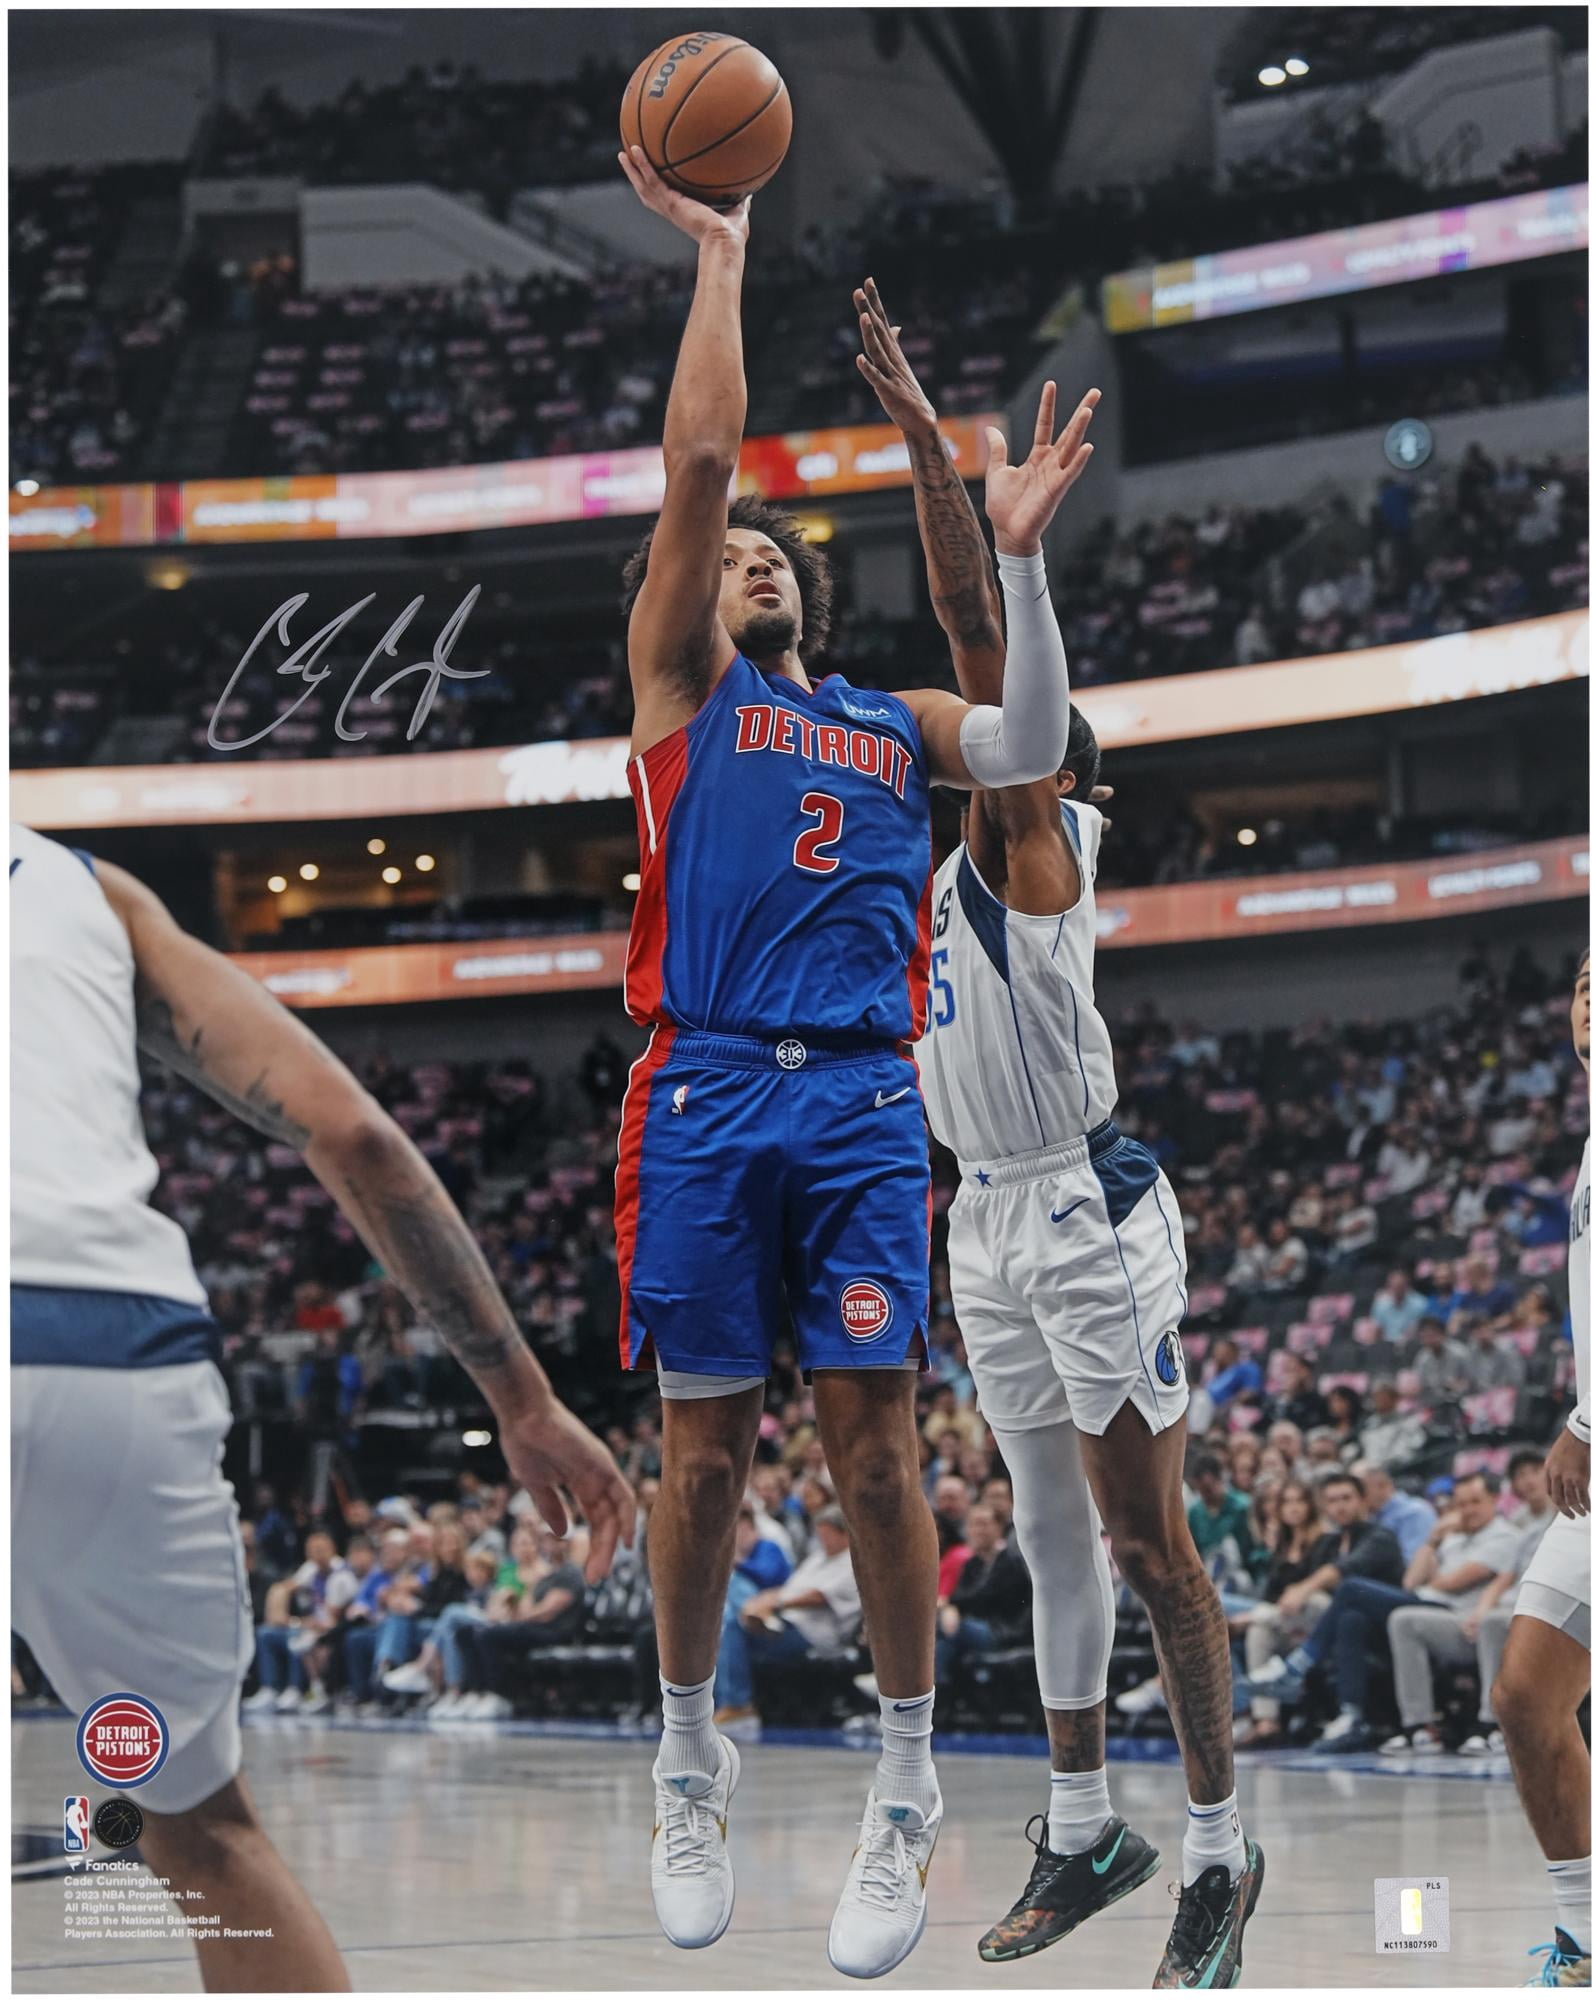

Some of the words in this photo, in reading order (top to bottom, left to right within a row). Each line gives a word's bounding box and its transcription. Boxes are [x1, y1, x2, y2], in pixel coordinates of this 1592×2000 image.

[735, 704, 913, 800] DETROIT
[793, 791, 844, 873] 2
[845, 1300, 880, 1310] DETROIT
[846, 1310, 880, 1320] PISTONS
[1426, 1882, 1441, 1890] PLS
[1384, 1941, 1438, 1949] NC113807590
